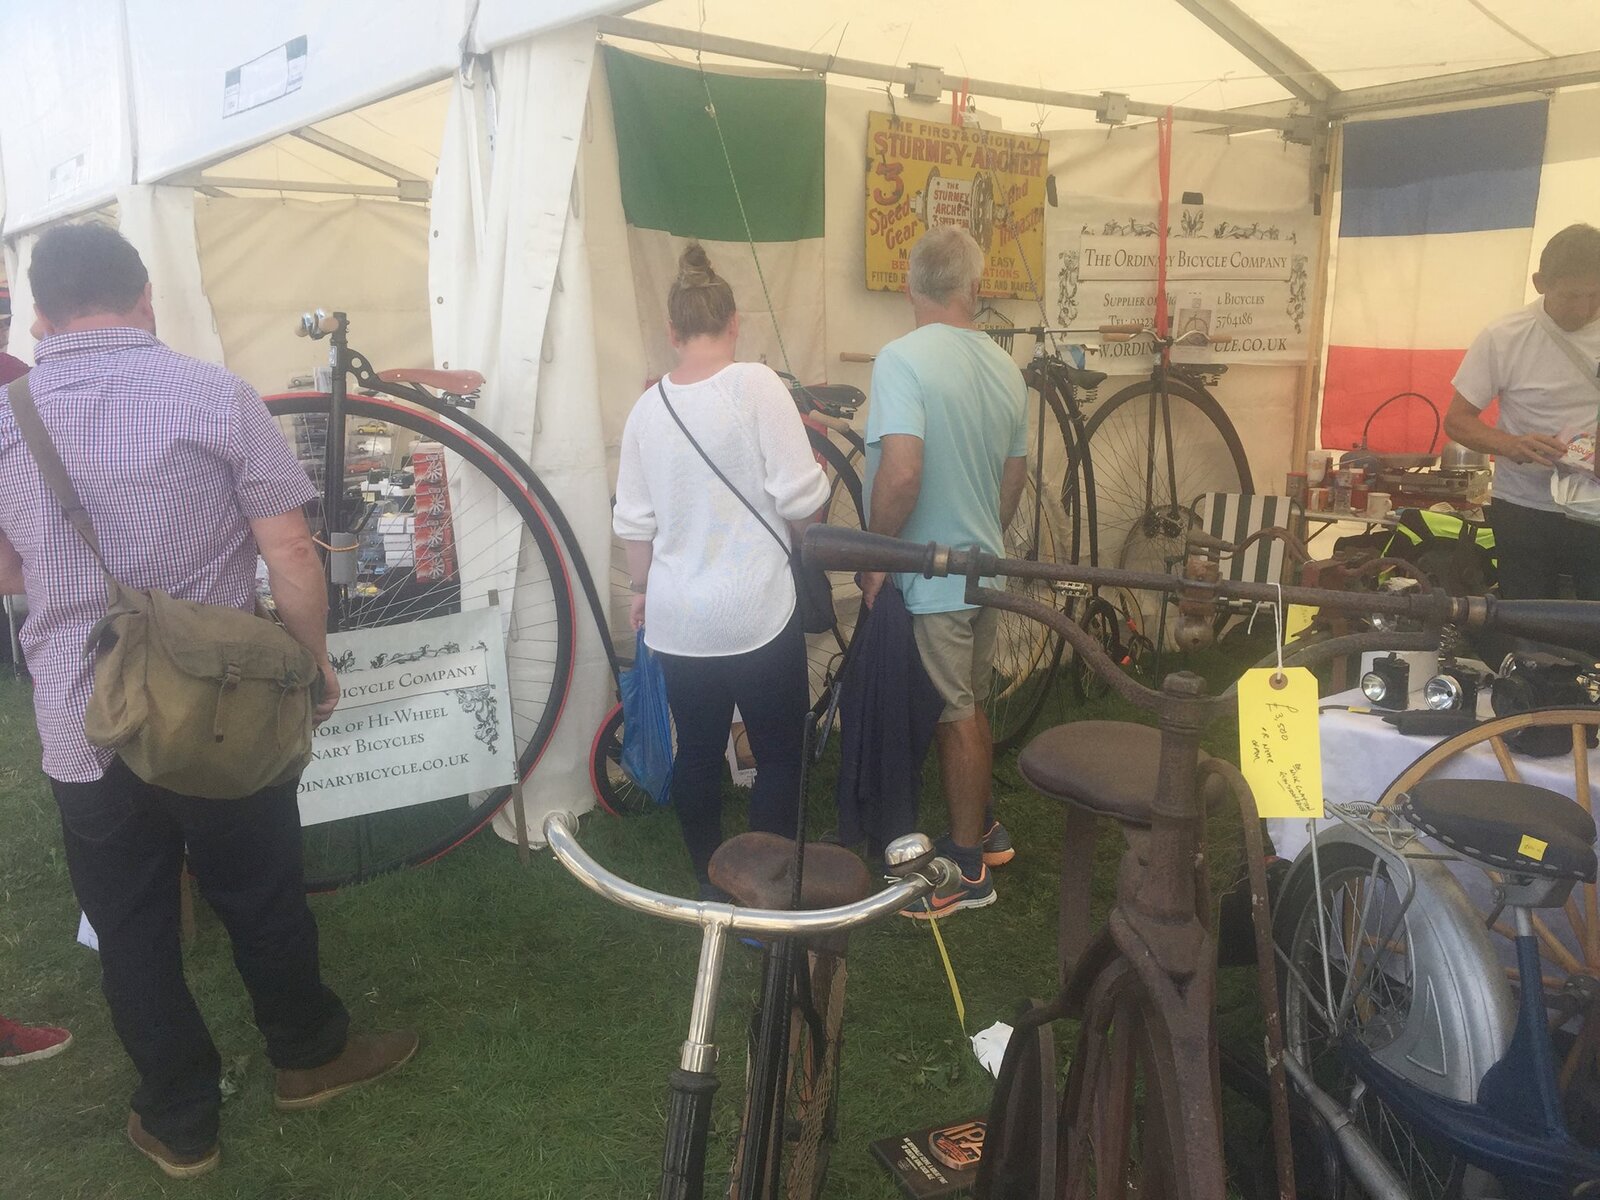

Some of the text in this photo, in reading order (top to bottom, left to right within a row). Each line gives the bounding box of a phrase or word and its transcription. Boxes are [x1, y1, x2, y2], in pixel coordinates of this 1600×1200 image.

[887, 119, 912, 134] THE
[920, 124, 960, 141] FIRST
[874, 131, 1043, 178] STURMEY-ARCHER
[873, 162, 905, 206] 3
[946, 182, 960, 190] THE
[934, 189, 970, 205] STURMEY
[869, 194, 918, 250] Speed Gear
[991, 256, 1015, 269] EASY
[1085, 249, 1288, 269] THE ORDINY BICYCLE COMPANY
[872, 271, 898, 283] FITTED
[983, 268, 1020, 280] ATIONS
[1103, 292, 1146, 307] SUPPLIER
[1225, 292, 1265, 305] BICYCLES
[1216, 312, 1253, 328] 5764186
[342, 664, 478, 698] ICYCLE COMPANY
[312, 707, 448, 738] TOR OF HI-WHEEL
[311, 733, 425, 761] NARY BICYCLES
[296, 753, 470, 795] DINARYBICYCLE.CO.UK
